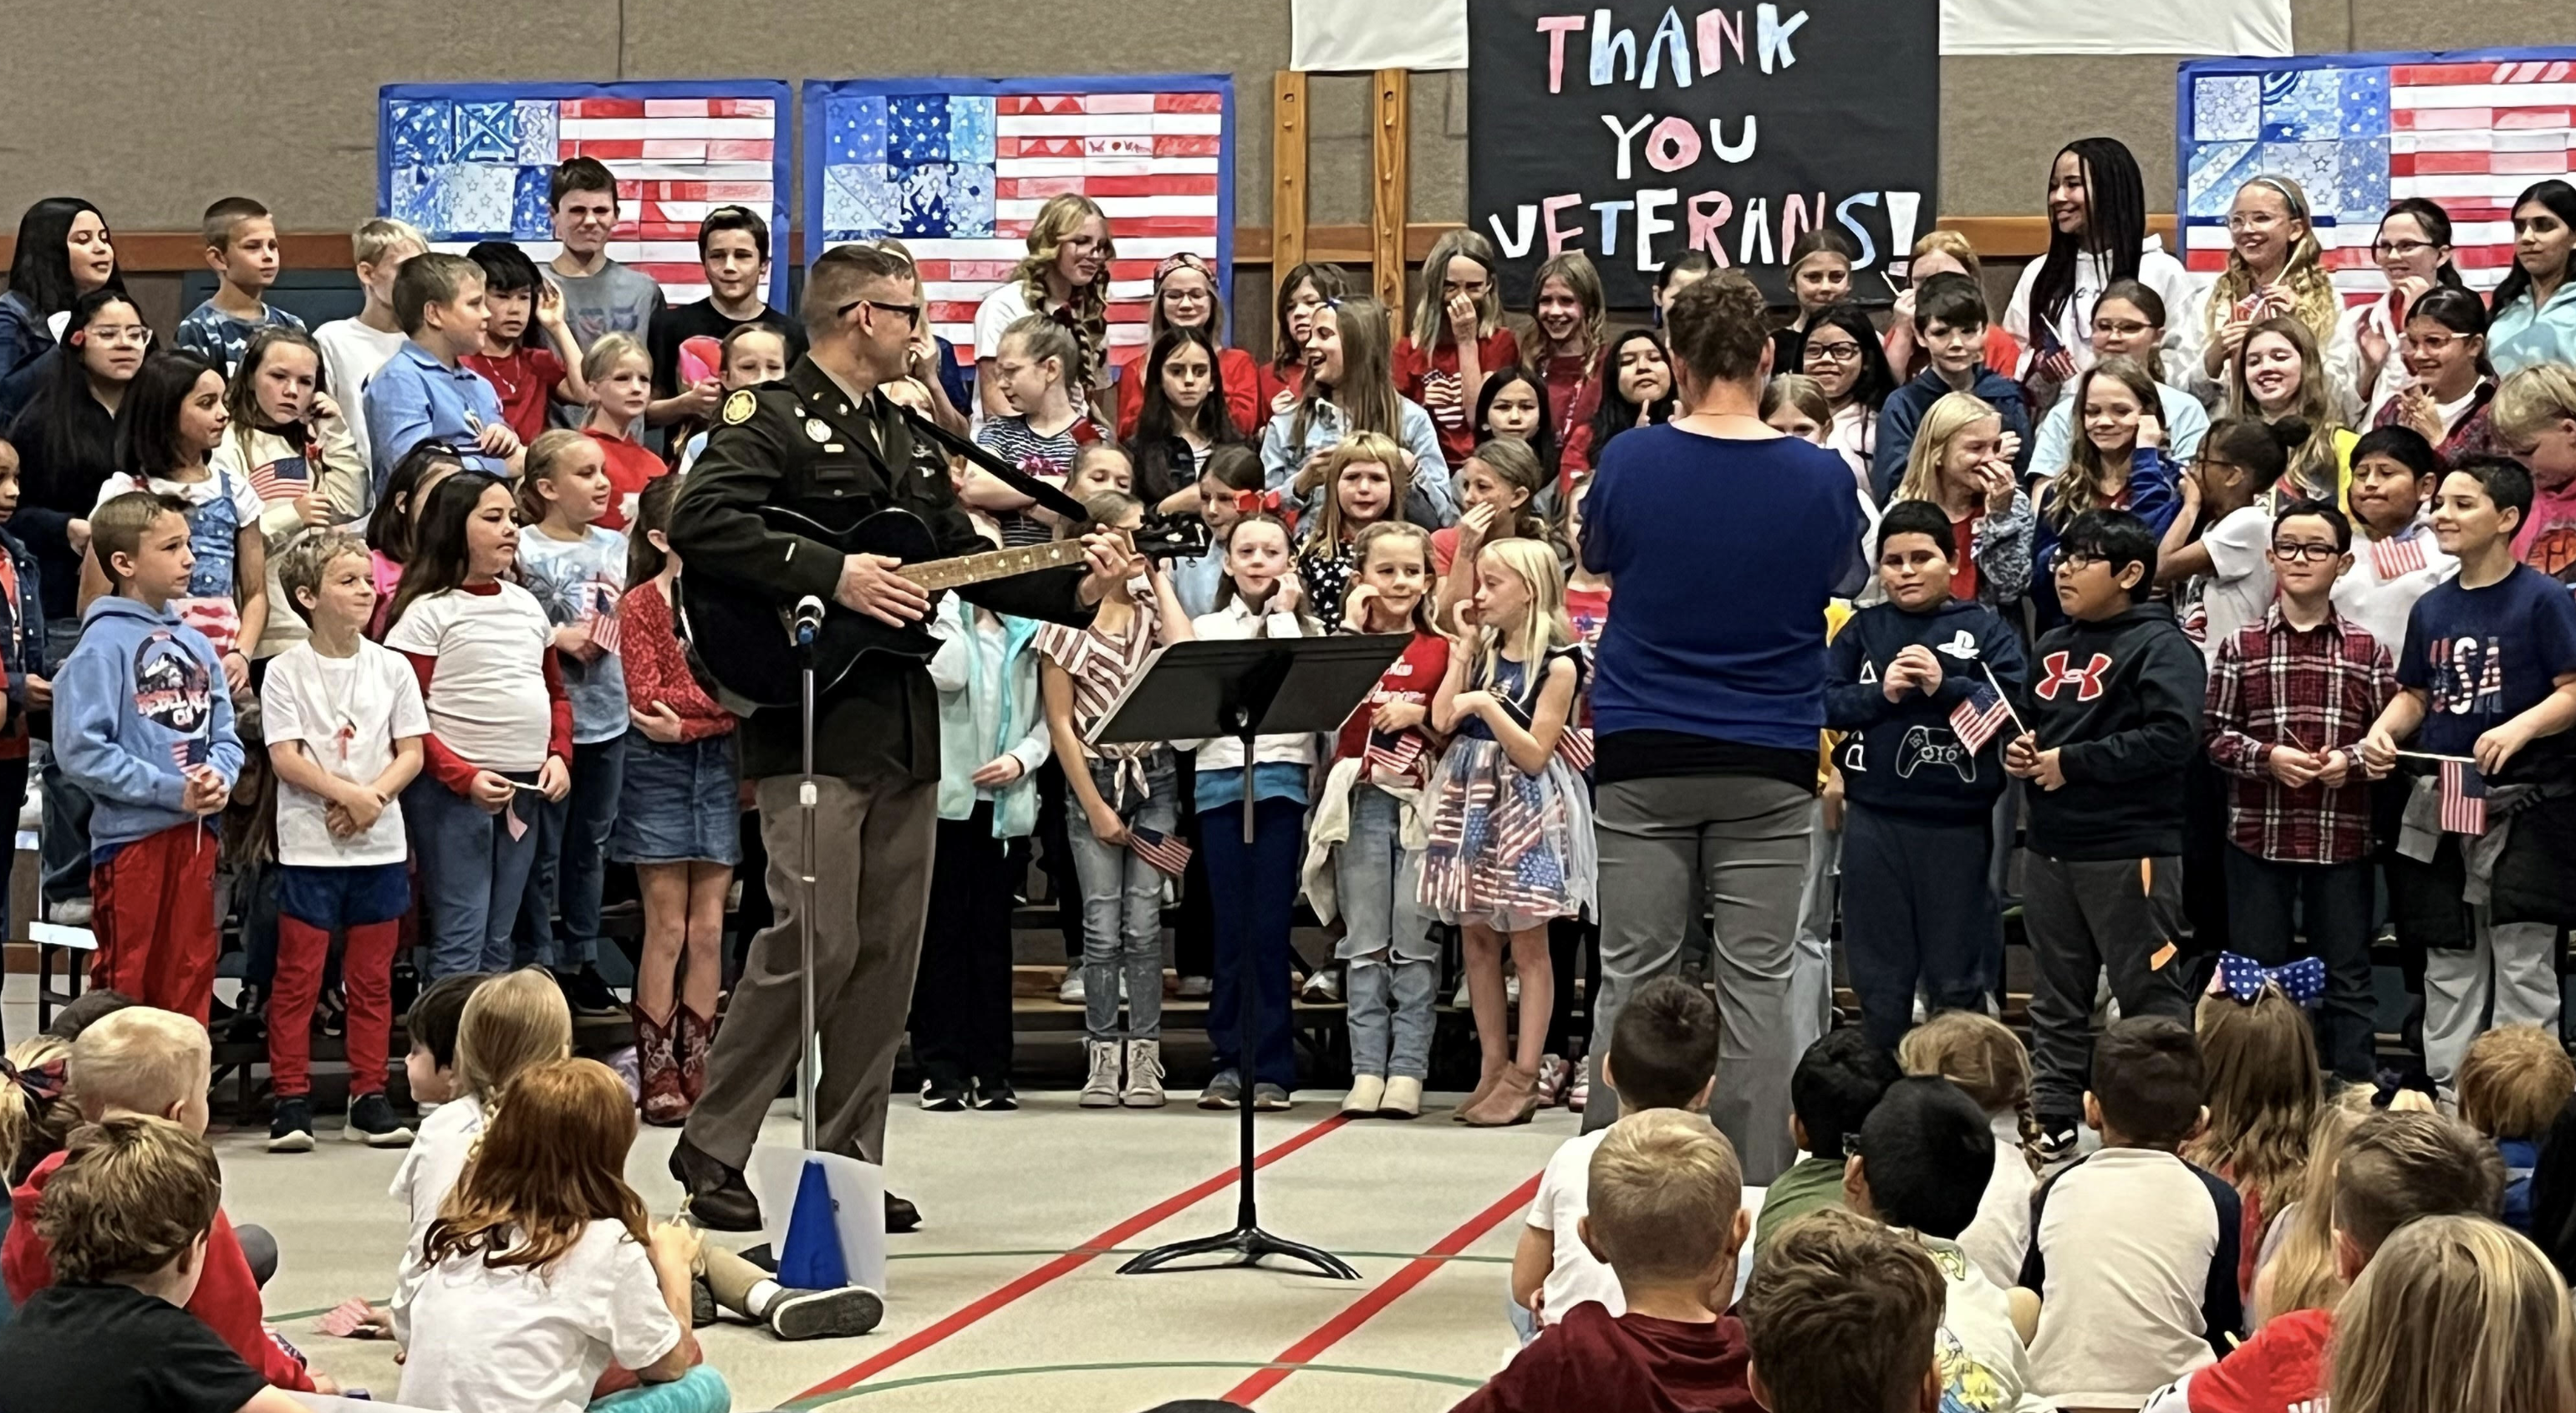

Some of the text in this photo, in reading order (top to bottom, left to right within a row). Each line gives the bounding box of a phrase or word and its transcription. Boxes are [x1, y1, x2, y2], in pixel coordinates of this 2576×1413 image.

[1601, 114, 1757, 179] YOU
[1489, 188, 1922, 278] VETERANS!
[2429, 636, 2502, 715] USA
